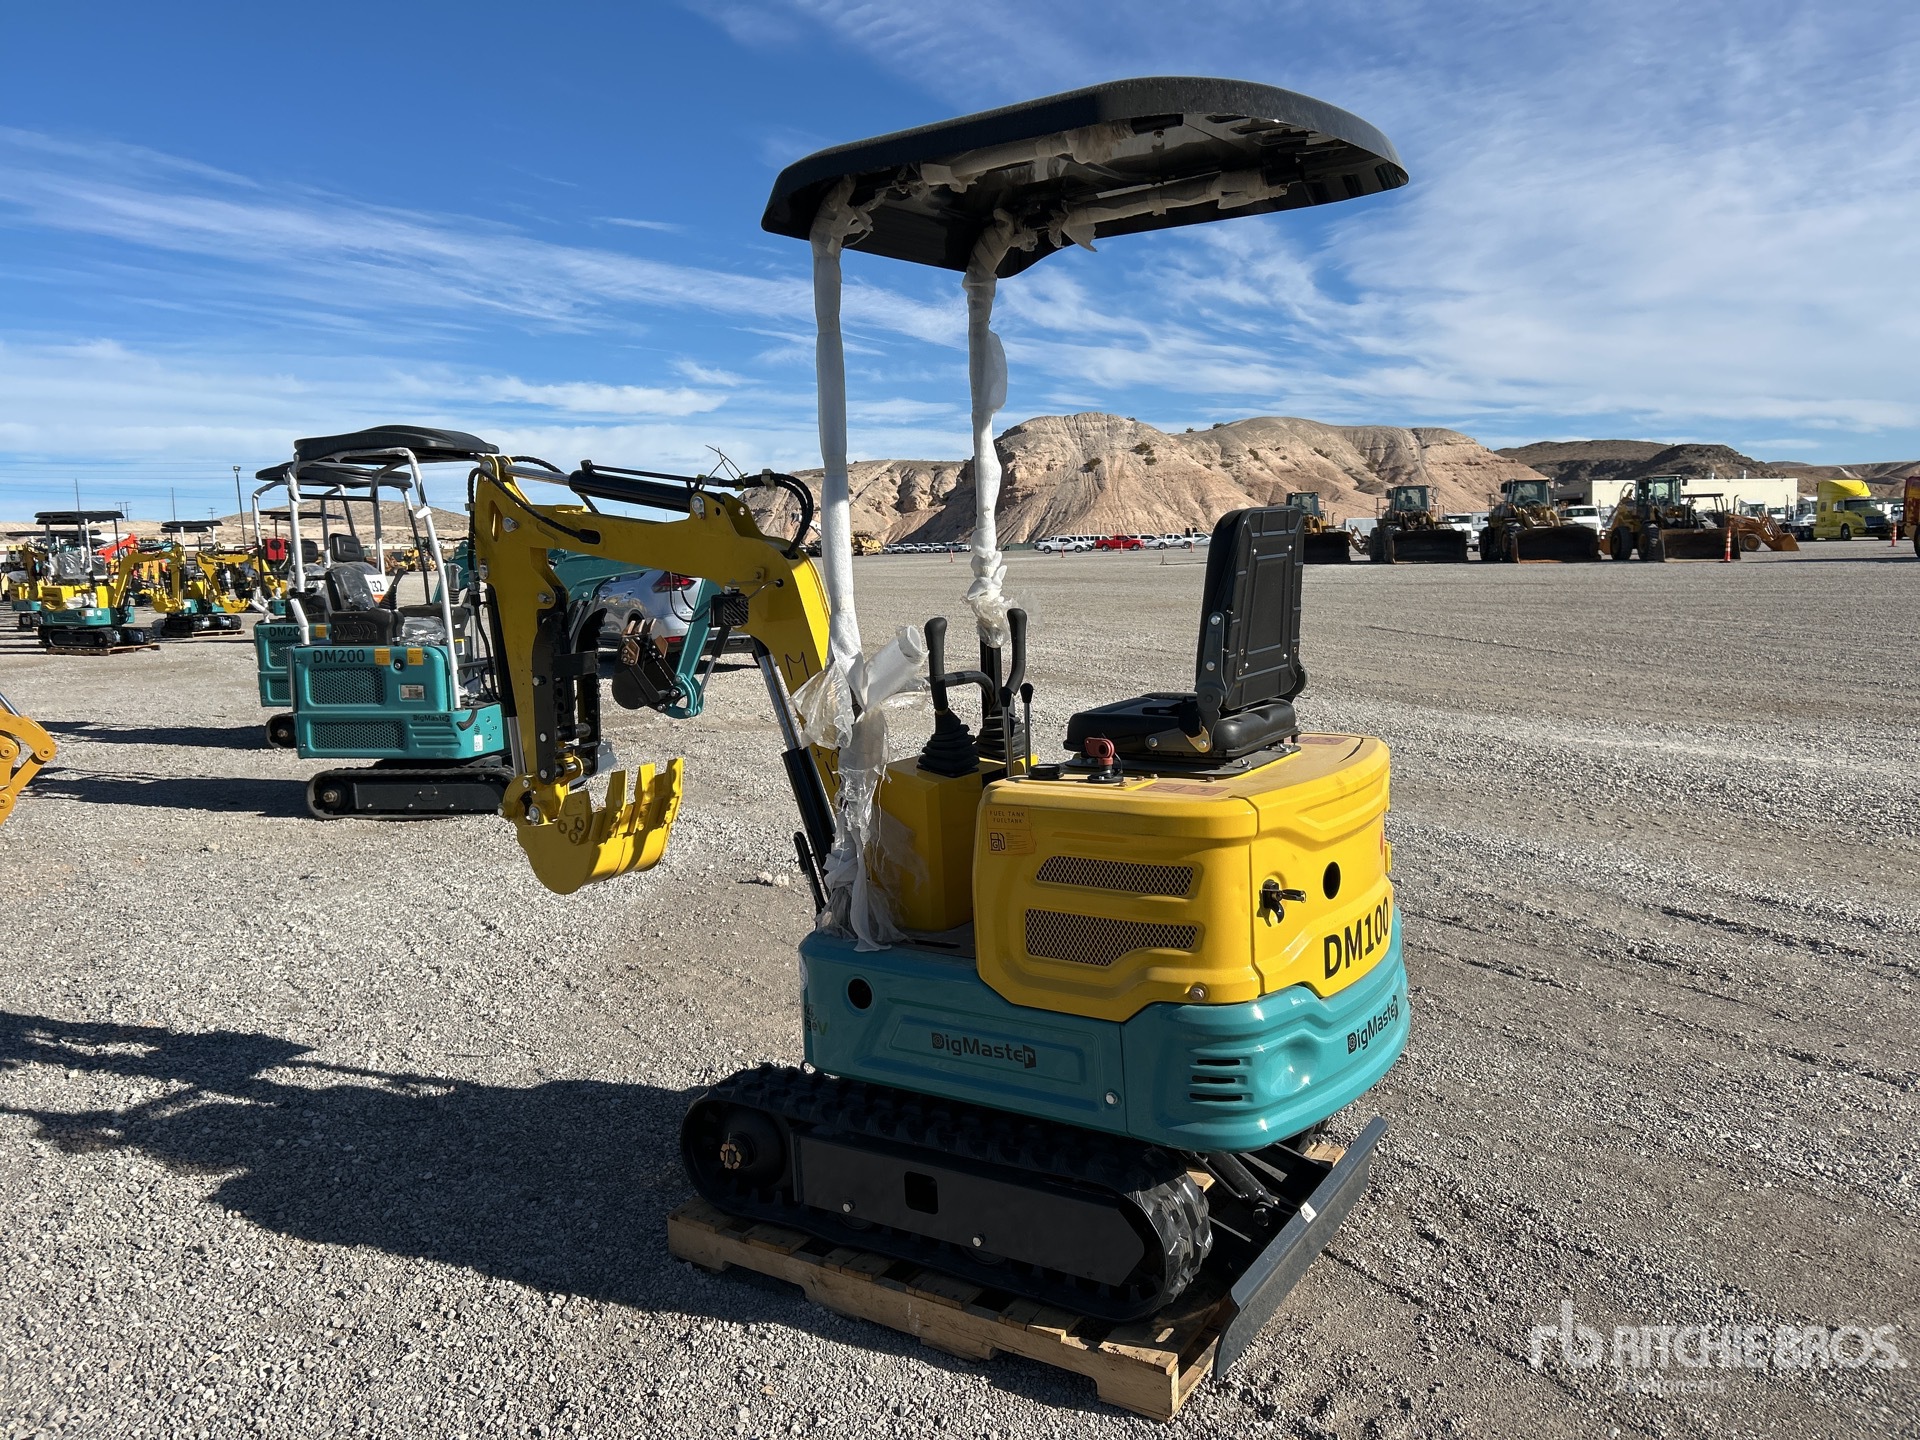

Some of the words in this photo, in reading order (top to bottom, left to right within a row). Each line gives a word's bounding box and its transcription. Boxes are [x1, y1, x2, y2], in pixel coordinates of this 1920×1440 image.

[269, 626, 300, 637] DM20
[313, 649, 366, 663] DM200
[1324, 897, 1388, 979] DM100
[1347, 995, 1398, 1054] DigMaster
[931, 1032, 1037, 1068] DigMaster
